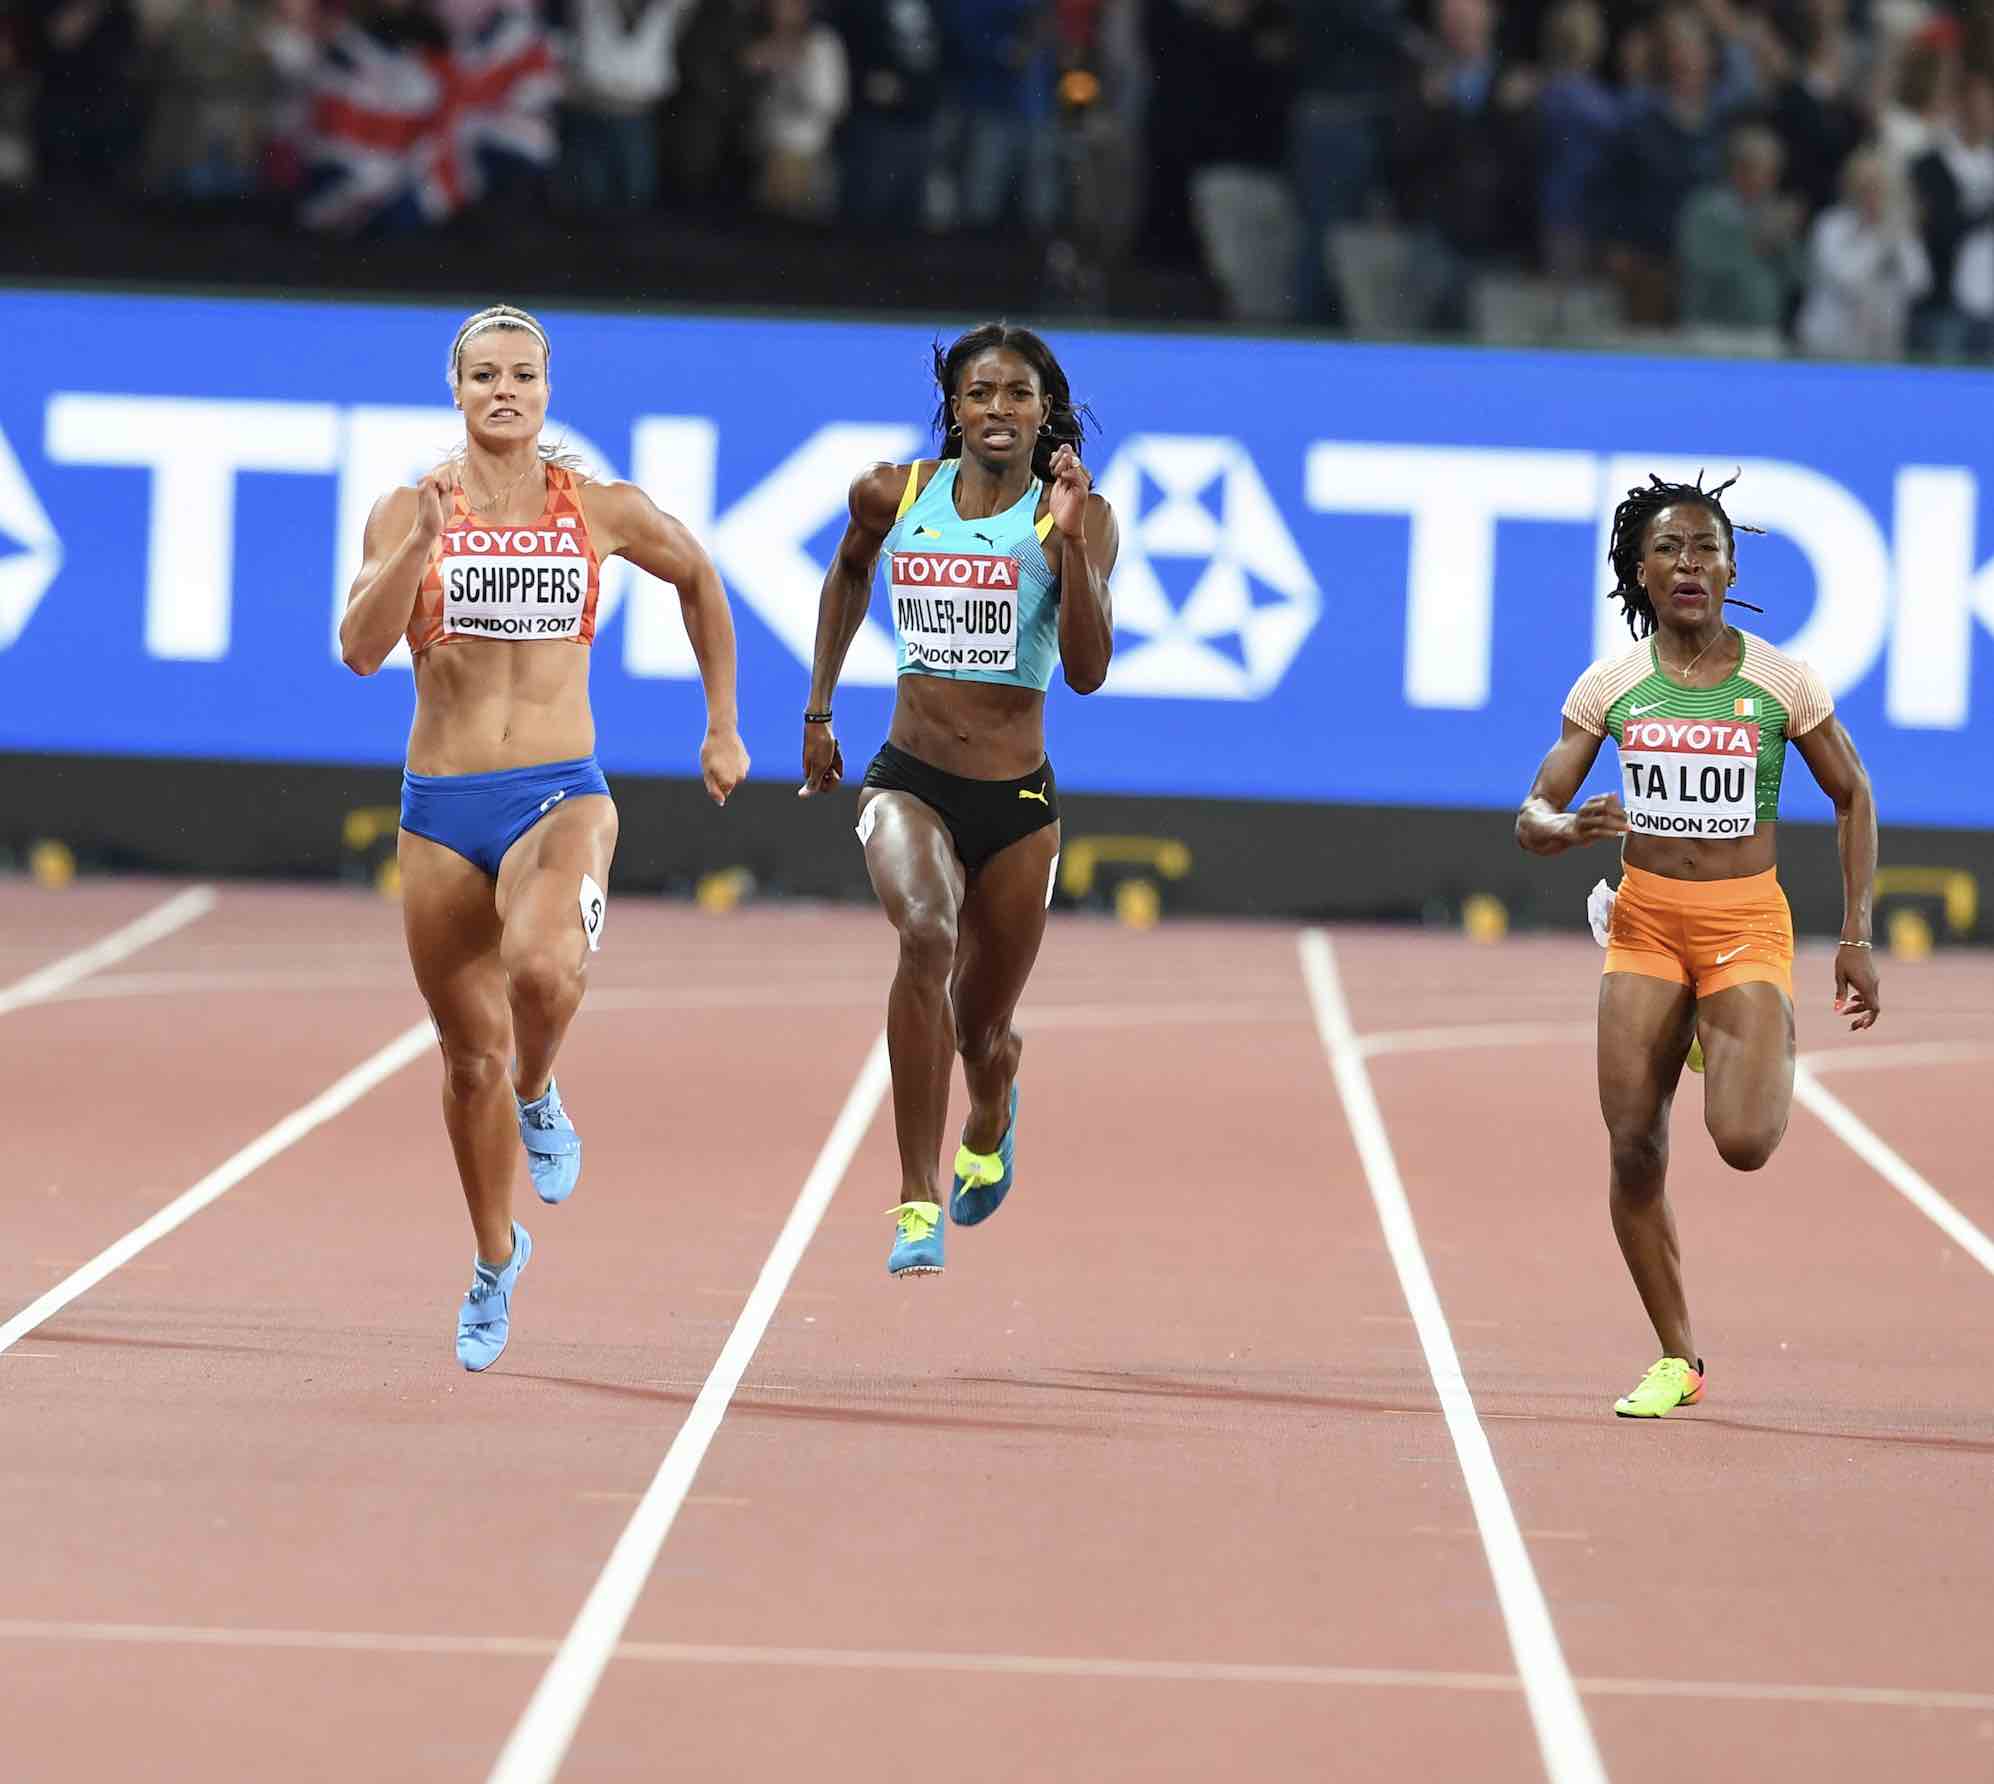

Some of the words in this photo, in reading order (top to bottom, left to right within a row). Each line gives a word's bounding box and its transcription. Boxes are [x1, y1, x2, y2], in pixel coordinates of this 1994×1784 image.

[446, 530, 581, 554] TOYOTA
[450, 567, 581, 604] SCHIPPERS
[894, 557, 1012, 586] TOYOTA
[450, 616, 532, 634] LONDON
[537, 617, 577, 633] 2017
[898, 598, 1012, 635] MILLER-UIBO
[907, 641, 963, 665] ONDON
[967, 649, 1010, 665] 2017
[1626, 723, 1753, 753] TOYOTA
[1626, 763, 1668, 801] TA
[1680, 765, 1745, 804] LOU
[1631, 810, 1702, 833] LONDON
[1707, 818, 1750, 834] 2017
